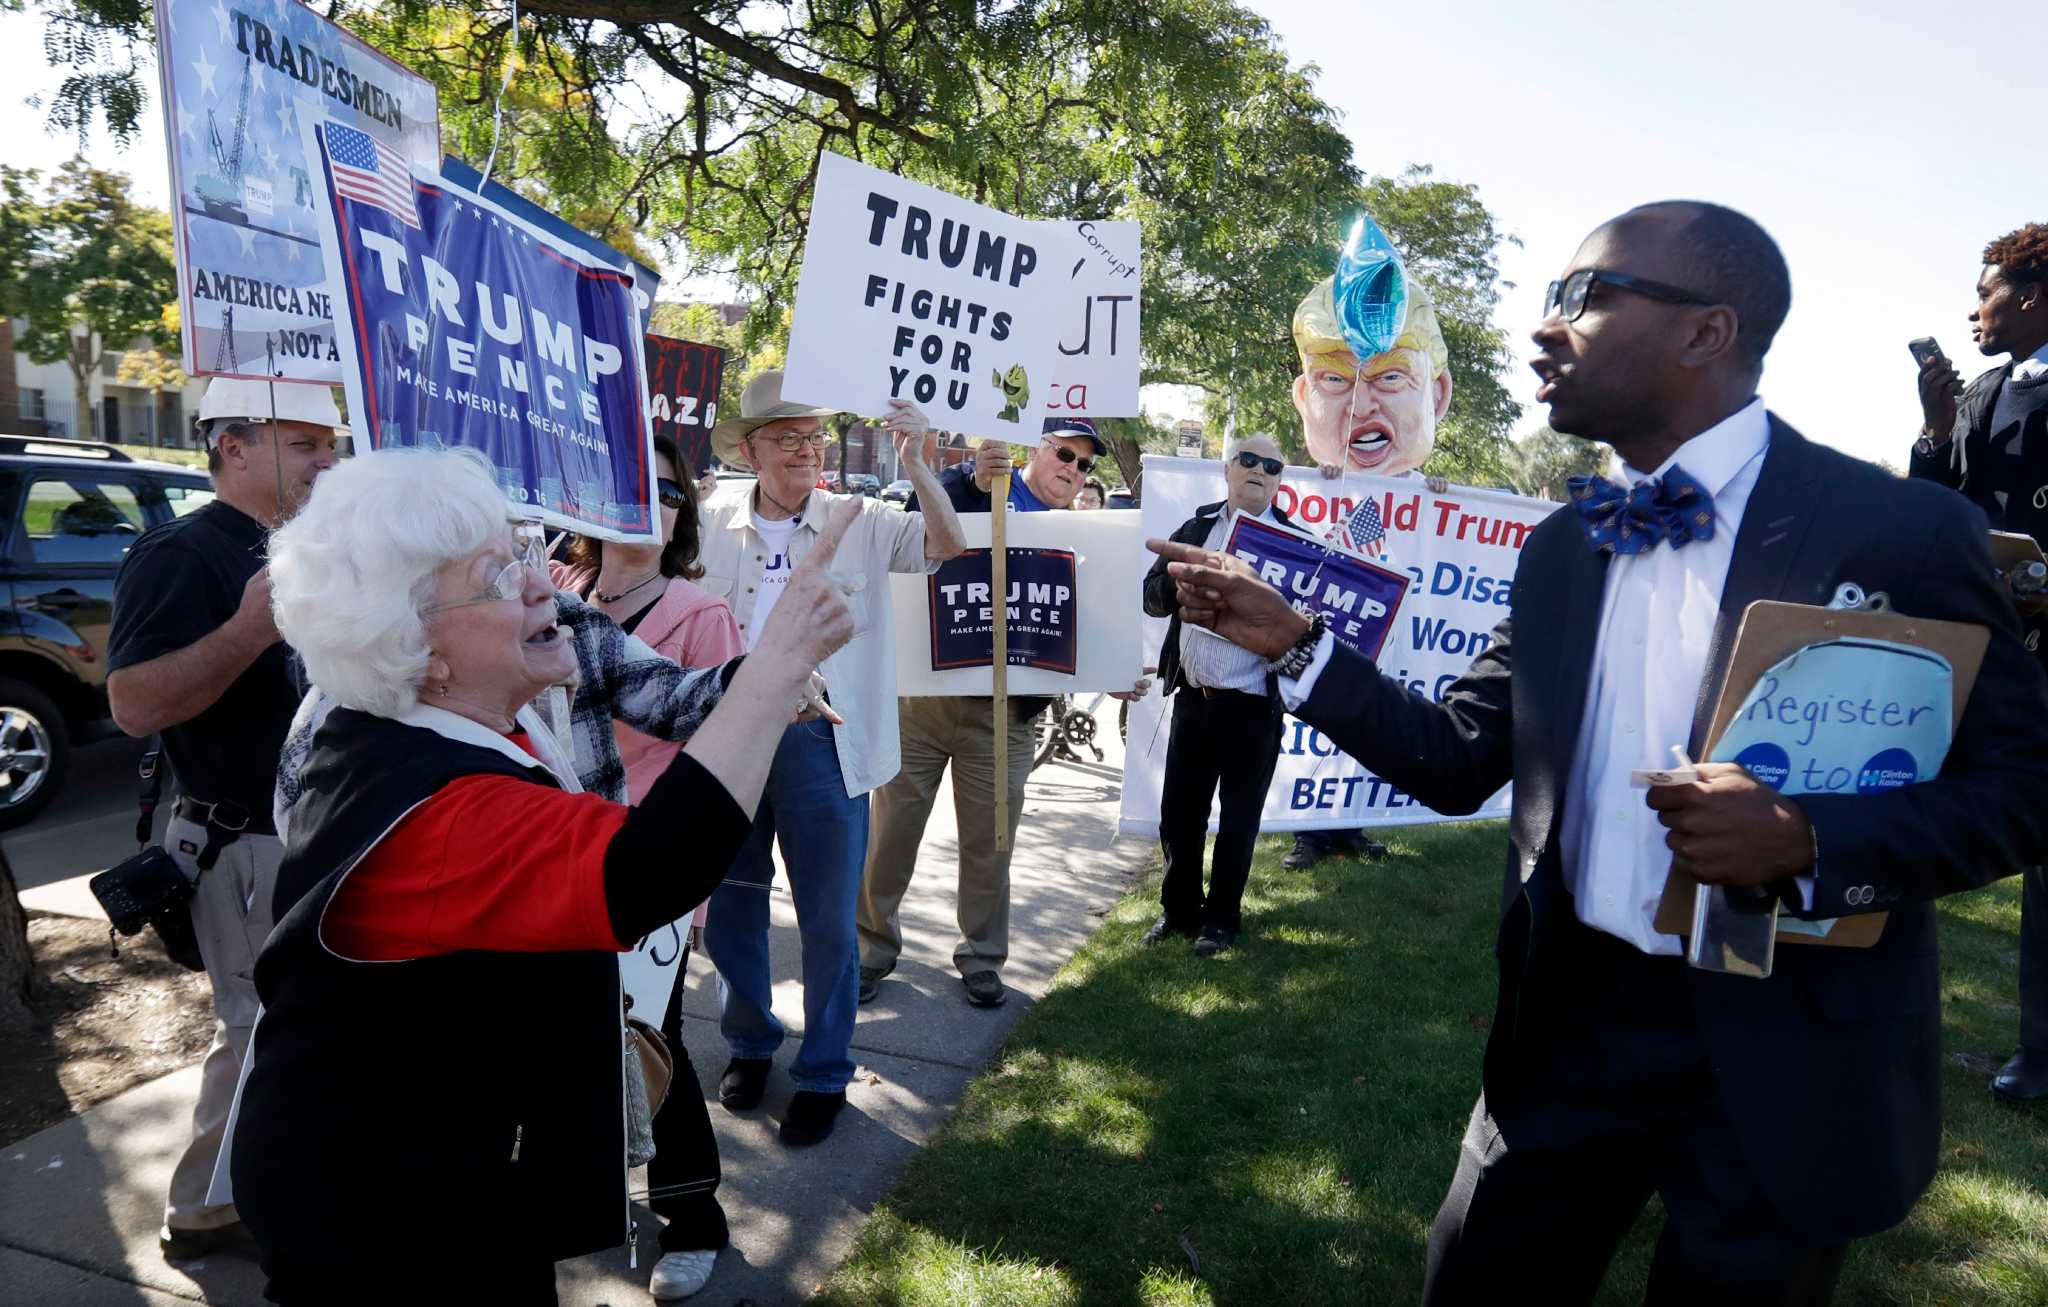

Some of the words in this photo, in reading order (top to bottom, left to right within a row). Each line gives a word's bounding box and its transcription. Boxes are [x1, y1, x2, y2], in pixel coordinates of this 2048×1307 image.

[229, 7, 402, 132] TRADESMEN
[866, 191, 1037, 288] TRUMP
[1077, 222, 1136, 280] Corrupt
[193, 268, 304, 316] AMERICA
[306, 290, 333, 320] NE
[360, 227, 623, 385] TRUMP
[864, 274, 1013, 341] FIGHTS
[279, 329, 322, 360] NOT
[405, 312, 601, 425] PENCE
[893, 325, 972, 373] FOR
[397, 365, 439, 398] MAKE
[444, 386, 520, 423] AMERICA
[526, 409, 567, 438] GREAT
[570, 429, 610, 457] AGAIN!
[889, 366, 969, 411] YOU
[508, 485, 547, 506] 2016
[1271, 484, 1421, 532] Donld
[940, 582, 1070, 606] TRUMP
[1234, 549, 1387, 621] TRUMP
[950, 626, 973, 635] MAKE
[1016, 625, 1039, 634] GREAT
[953, 607, 1060, 624] PENCE
[1747, 677, 1935, 747] Register
[1752, 763, 1788, 776] Clinton
[1801, 758, 1853, 792] to
[1880, 769, 1914, 781] Clinton
